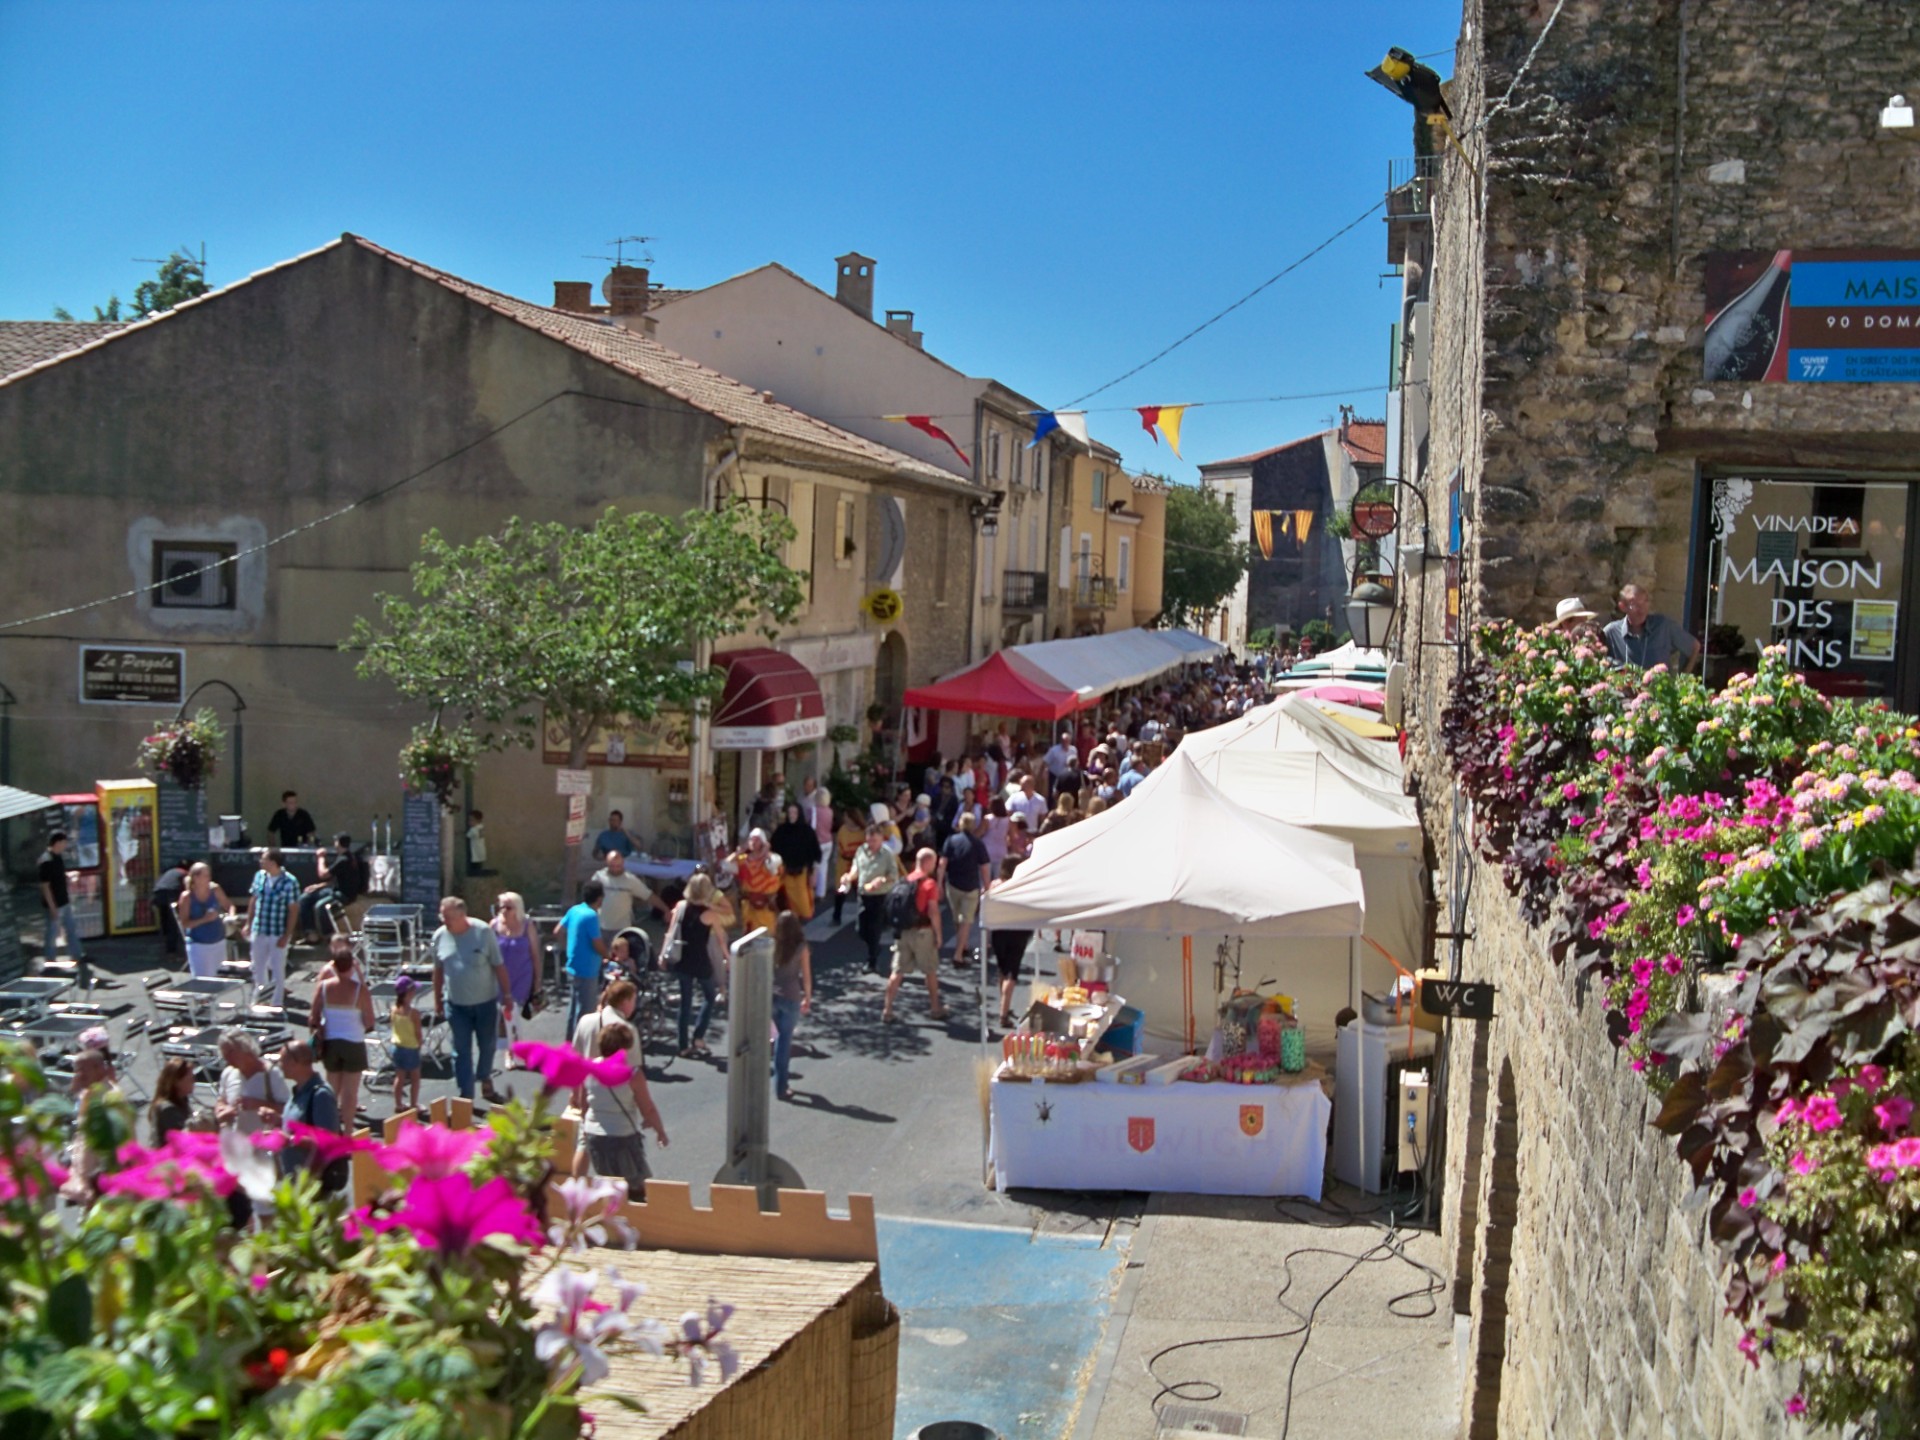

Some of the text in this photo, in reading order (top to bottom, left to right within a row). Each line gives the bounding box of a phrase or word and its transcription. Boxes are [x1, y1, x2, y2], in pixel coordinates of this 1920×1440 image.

[1826, 316, 1850, 328] 90
[1800, 356, 1829, 365] OUVERT
[1803, 365, 1826, 377] 7/7
[1752, 514, 1857, 534] VINADEA
[1722, 555, 1882, 590] MAISON
[1770, 598, 1833, 628] DES
[1435, 984, 1475, 1007] WC
